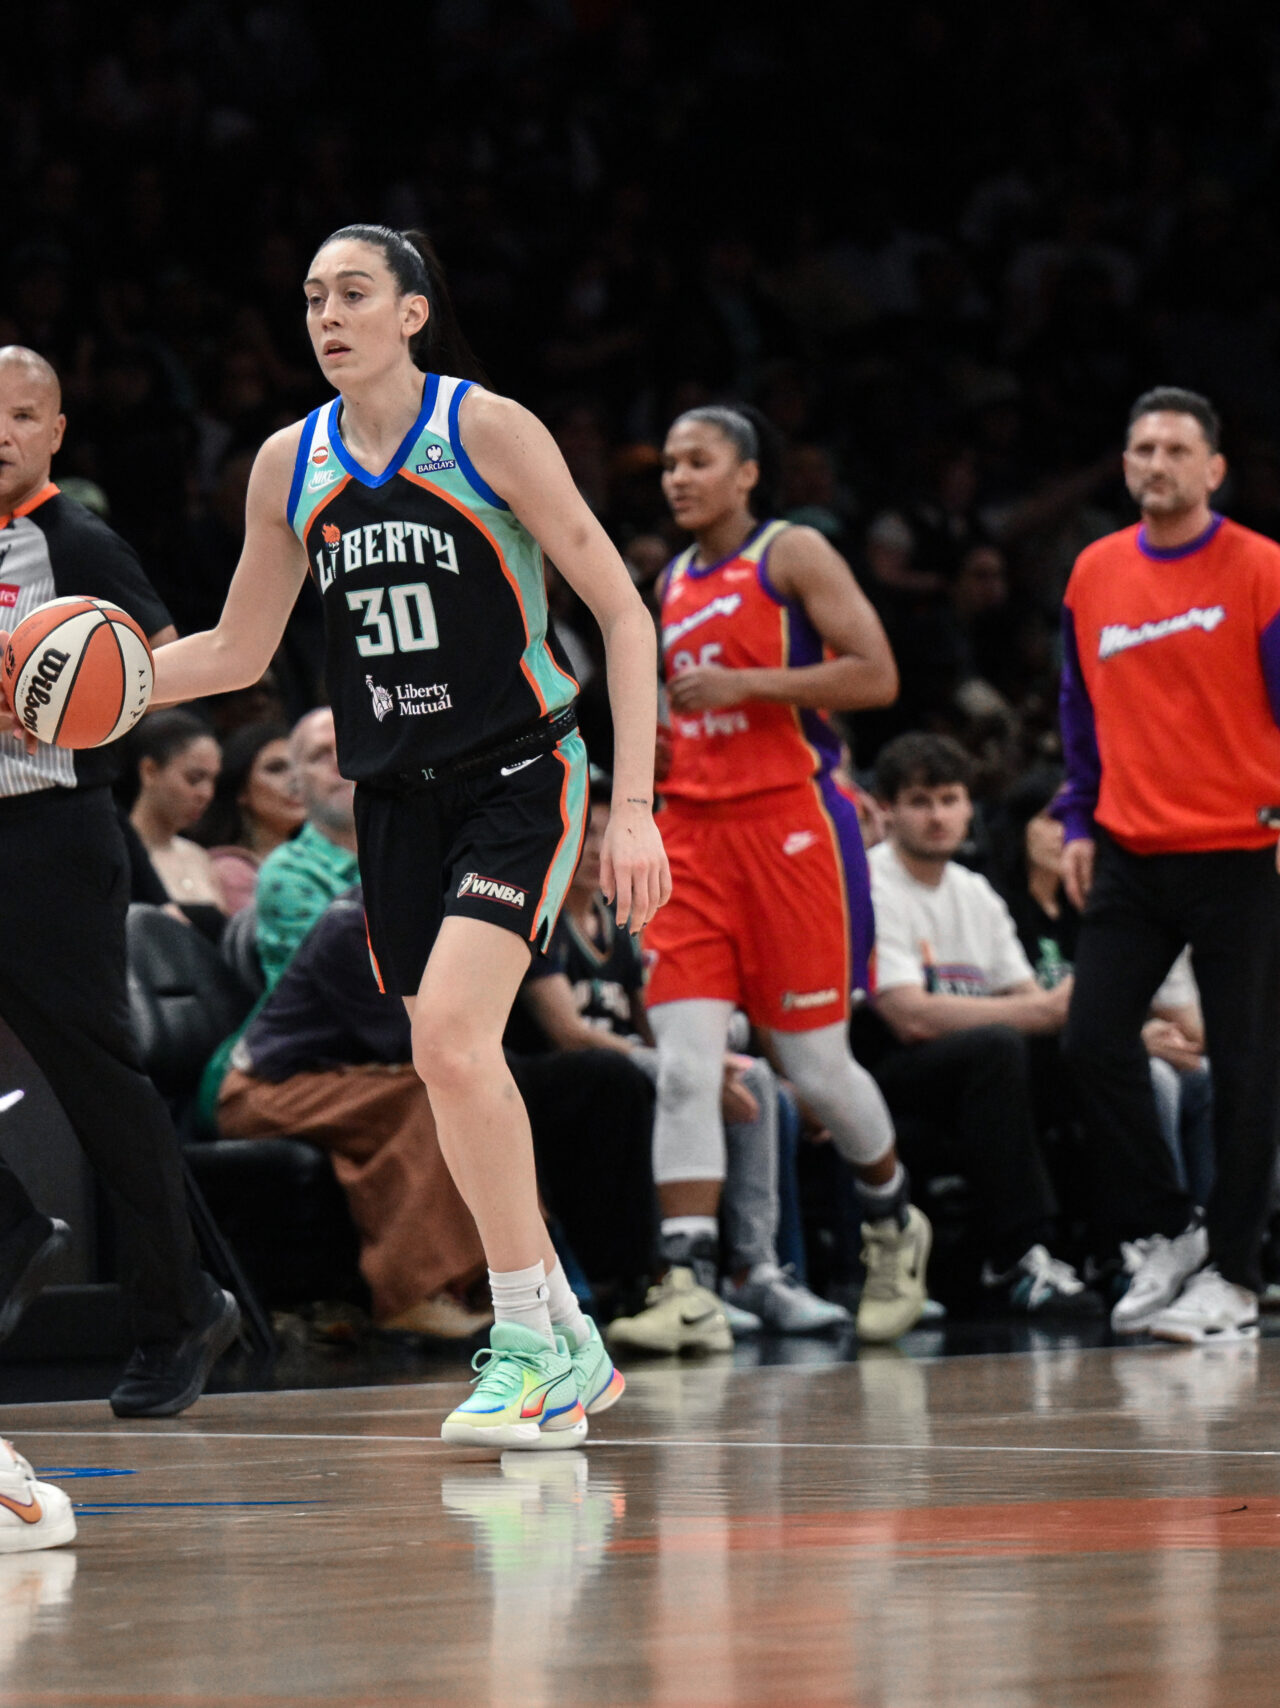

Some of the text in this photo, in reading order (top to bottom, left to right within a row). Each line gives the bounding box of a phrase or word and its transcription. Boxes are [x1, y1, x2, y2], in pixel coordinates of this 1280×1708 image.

[417, 460, 455, 473] BARCLAYS
[311, 469, 335, 486] NIKE
[345, 582, 440, 658] 30
[23, 647, 72, 734] Wilson
[395, 683, 449, 701] Liberty
[399, 698, 453, 717] Mutual
[471, 878, 526, 908] WNBA
